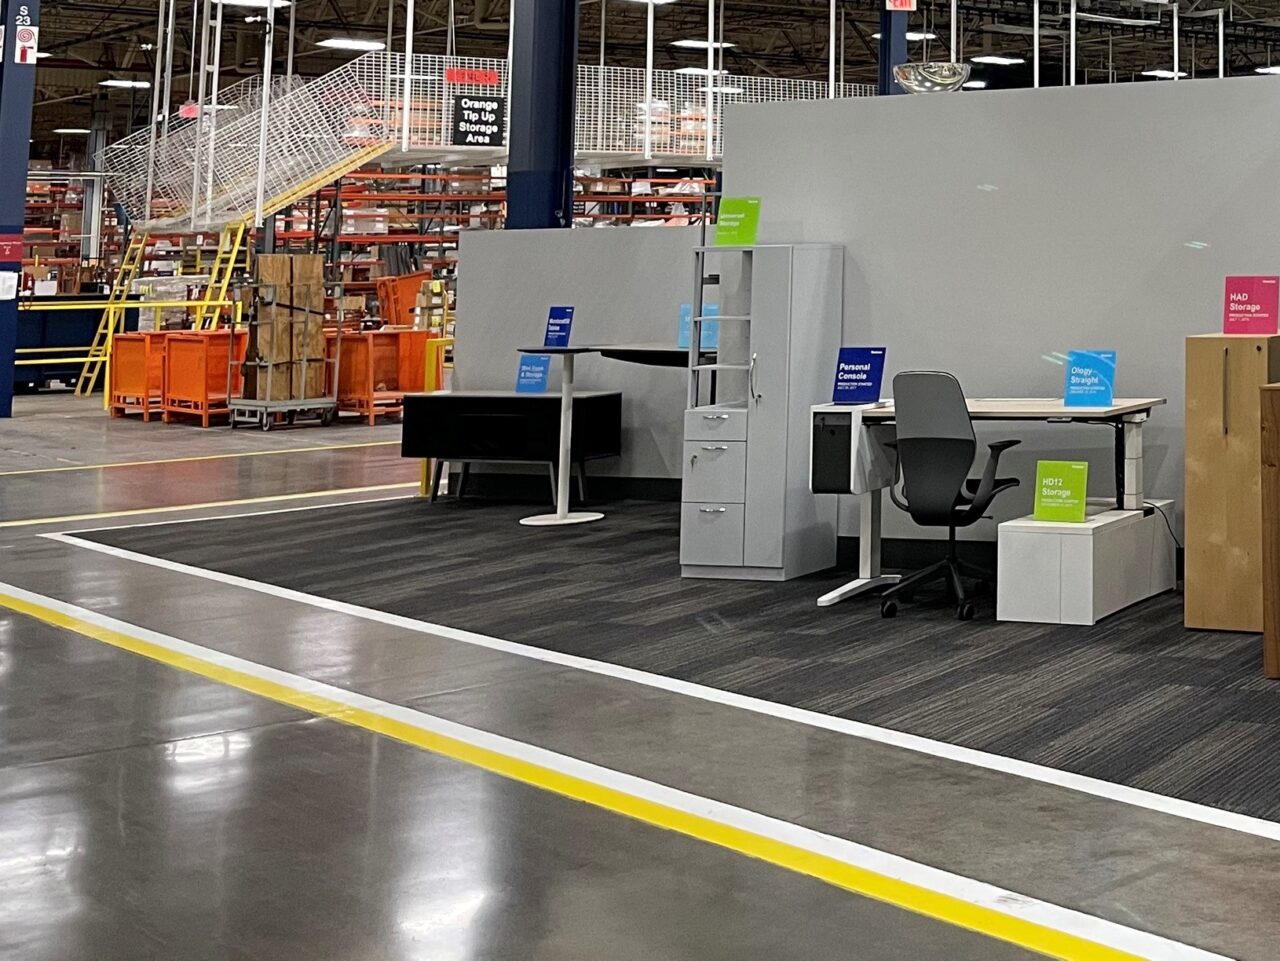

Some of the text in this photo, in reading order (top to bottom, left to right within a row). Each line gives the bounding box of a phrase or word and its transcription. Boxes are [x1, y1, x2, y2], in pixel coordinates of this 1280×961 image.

[19, 6, 28, 15] S
[15, 16, 31, 26] 23
[461, 98, 498, 111] Orange
[463, 110, 496, 123] Tip Up
[459, 122, 498, 134] Storage
[466, 133, 490, 143] Area
[1230, 293, 1248, 301] HAD
[1230, 303, 1260, 312] Storage
[840, 363, 870, 371] Personal
[1071, 367, 1093, 376] Ology
[838, 372, 867, 380] Console
[1070, 376, 1099, 385] Straight
[1042, 478, 1063, 486] HD12
[1042, 488, 1071, 498] Storage
